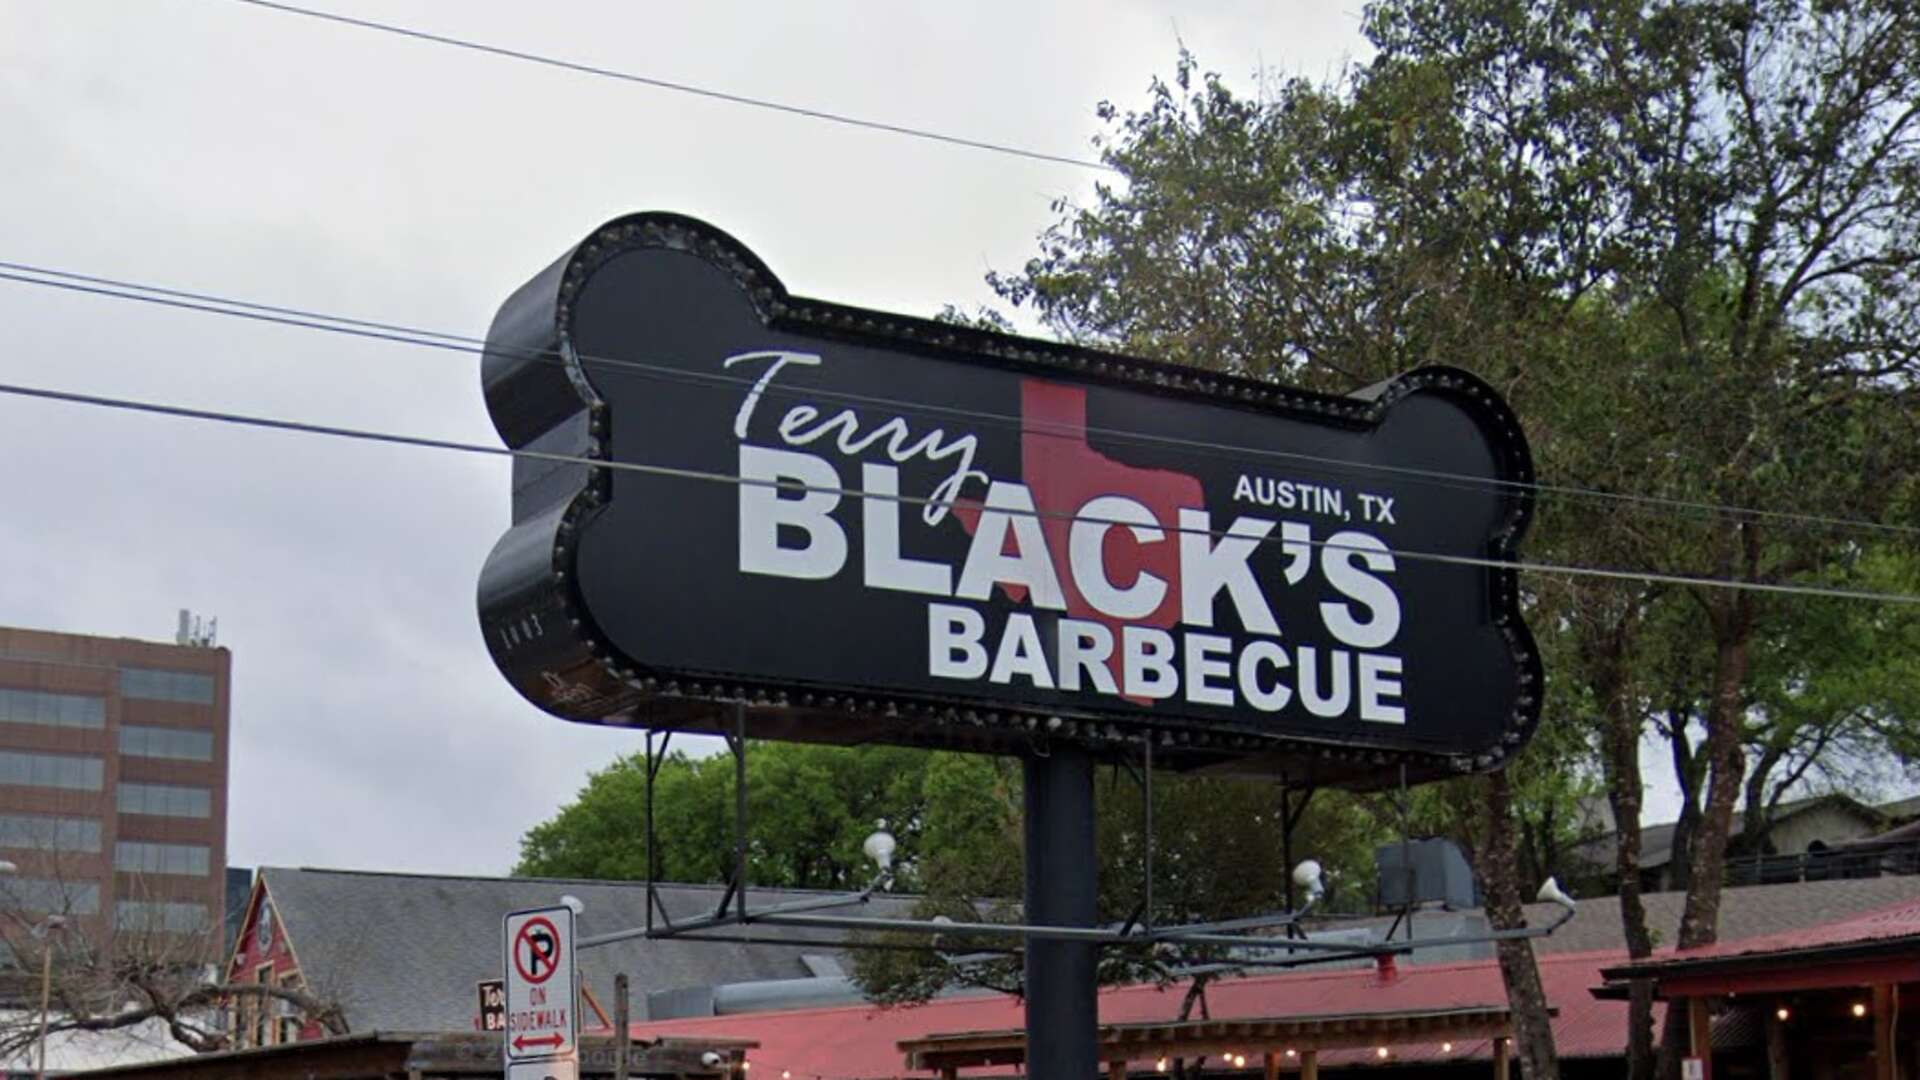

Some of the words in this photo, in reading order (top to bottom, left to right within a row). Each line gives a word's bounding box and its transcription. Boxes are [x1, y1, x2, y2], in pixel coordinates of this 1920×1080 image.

[723, 351, 989, 526] Terry
[1233, 474, 1351, 521] AUSTIN,
[1358, 493, 1396, 525] TX
[738, 444, 1401, 649] BLACK'S
[928, 602, 1407, 725] BARBECUE
[510, 1009, 567, 1031] SIDEWALK
[529, 988, 547, 1006] ON
